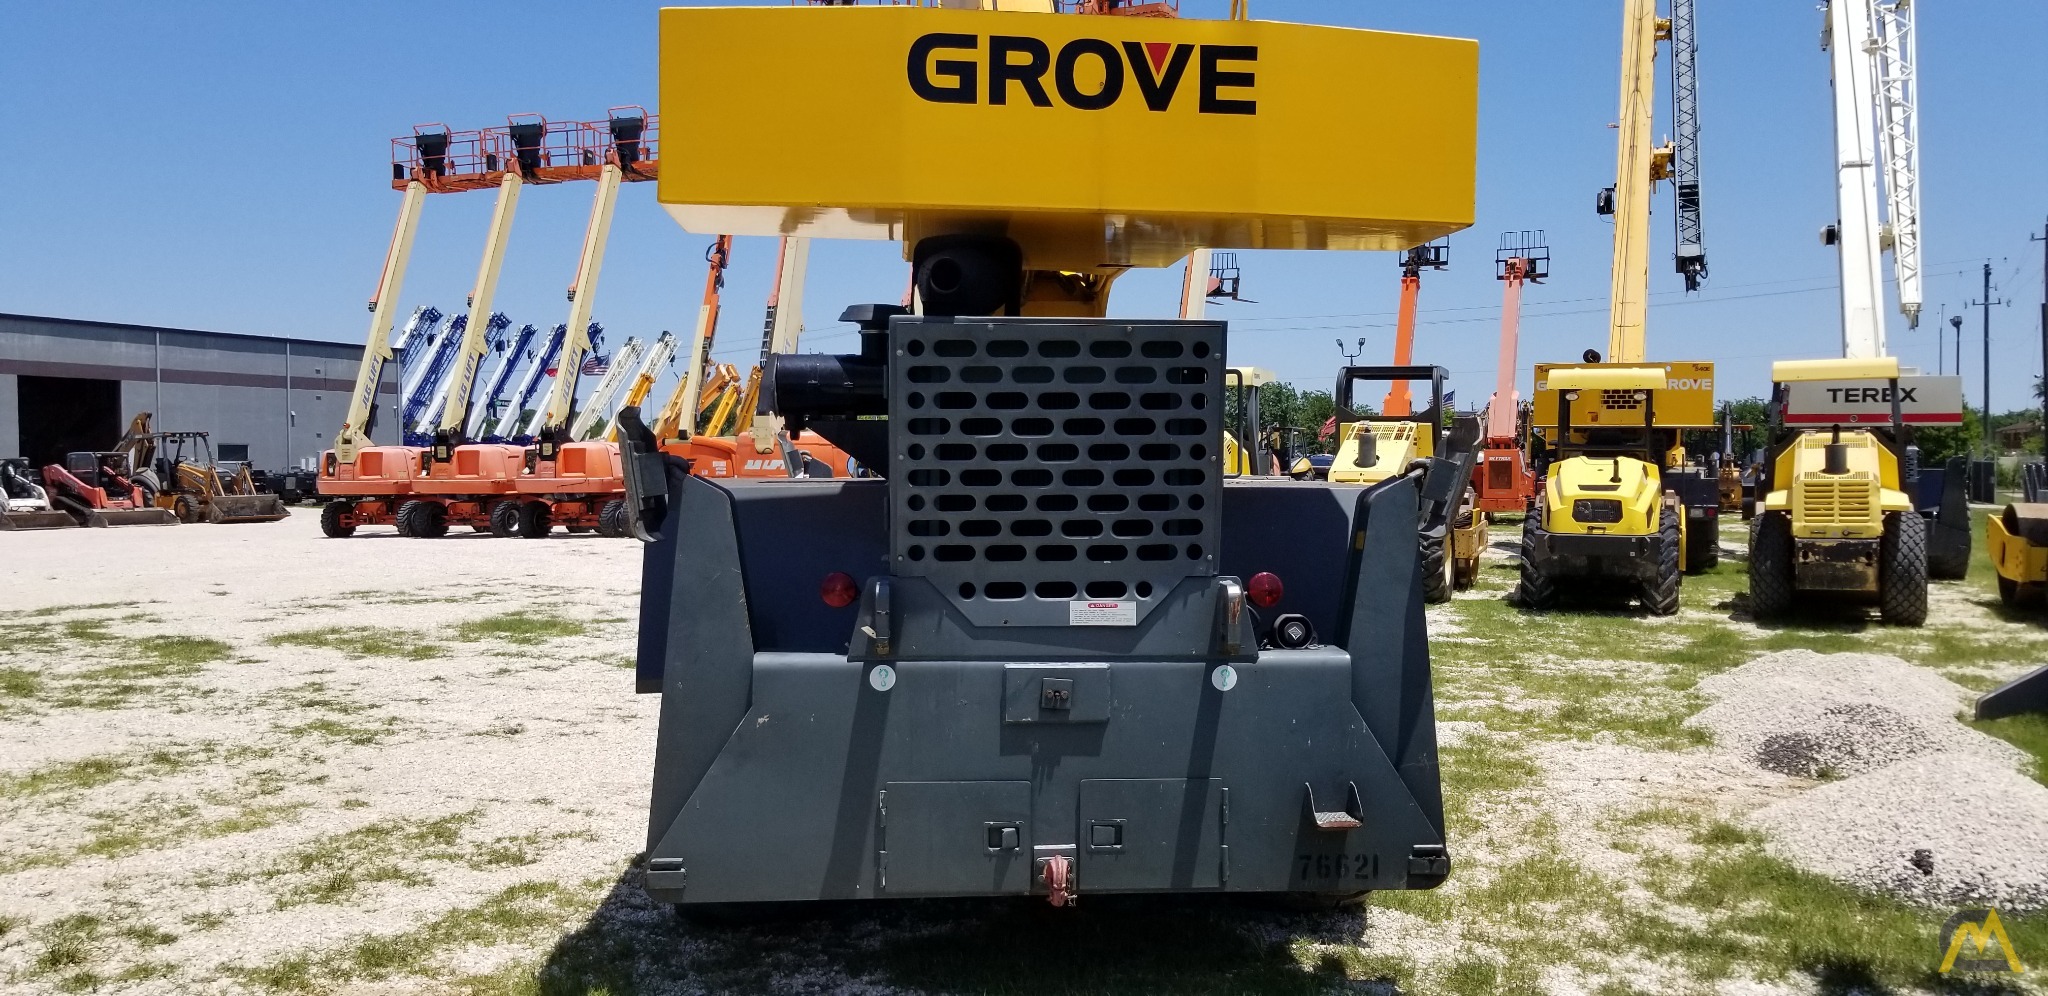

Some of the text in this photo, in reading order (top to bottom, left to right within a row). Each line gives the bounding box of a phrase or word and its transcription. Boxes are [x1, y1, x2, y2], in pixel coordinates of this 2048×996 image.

[907, 32, 1258, 115] GROVE
[362, 354, 380, 410] JLG LIFT
[458, 351, 476, 408] JLG LIFT
[561, 346, 579, 404] JLG LIFT
[1667, 378, 1713, 391] ROVE
[1827, 387, 1918, 403] TEREX
[1300, 853, 1379, 881] 76621
